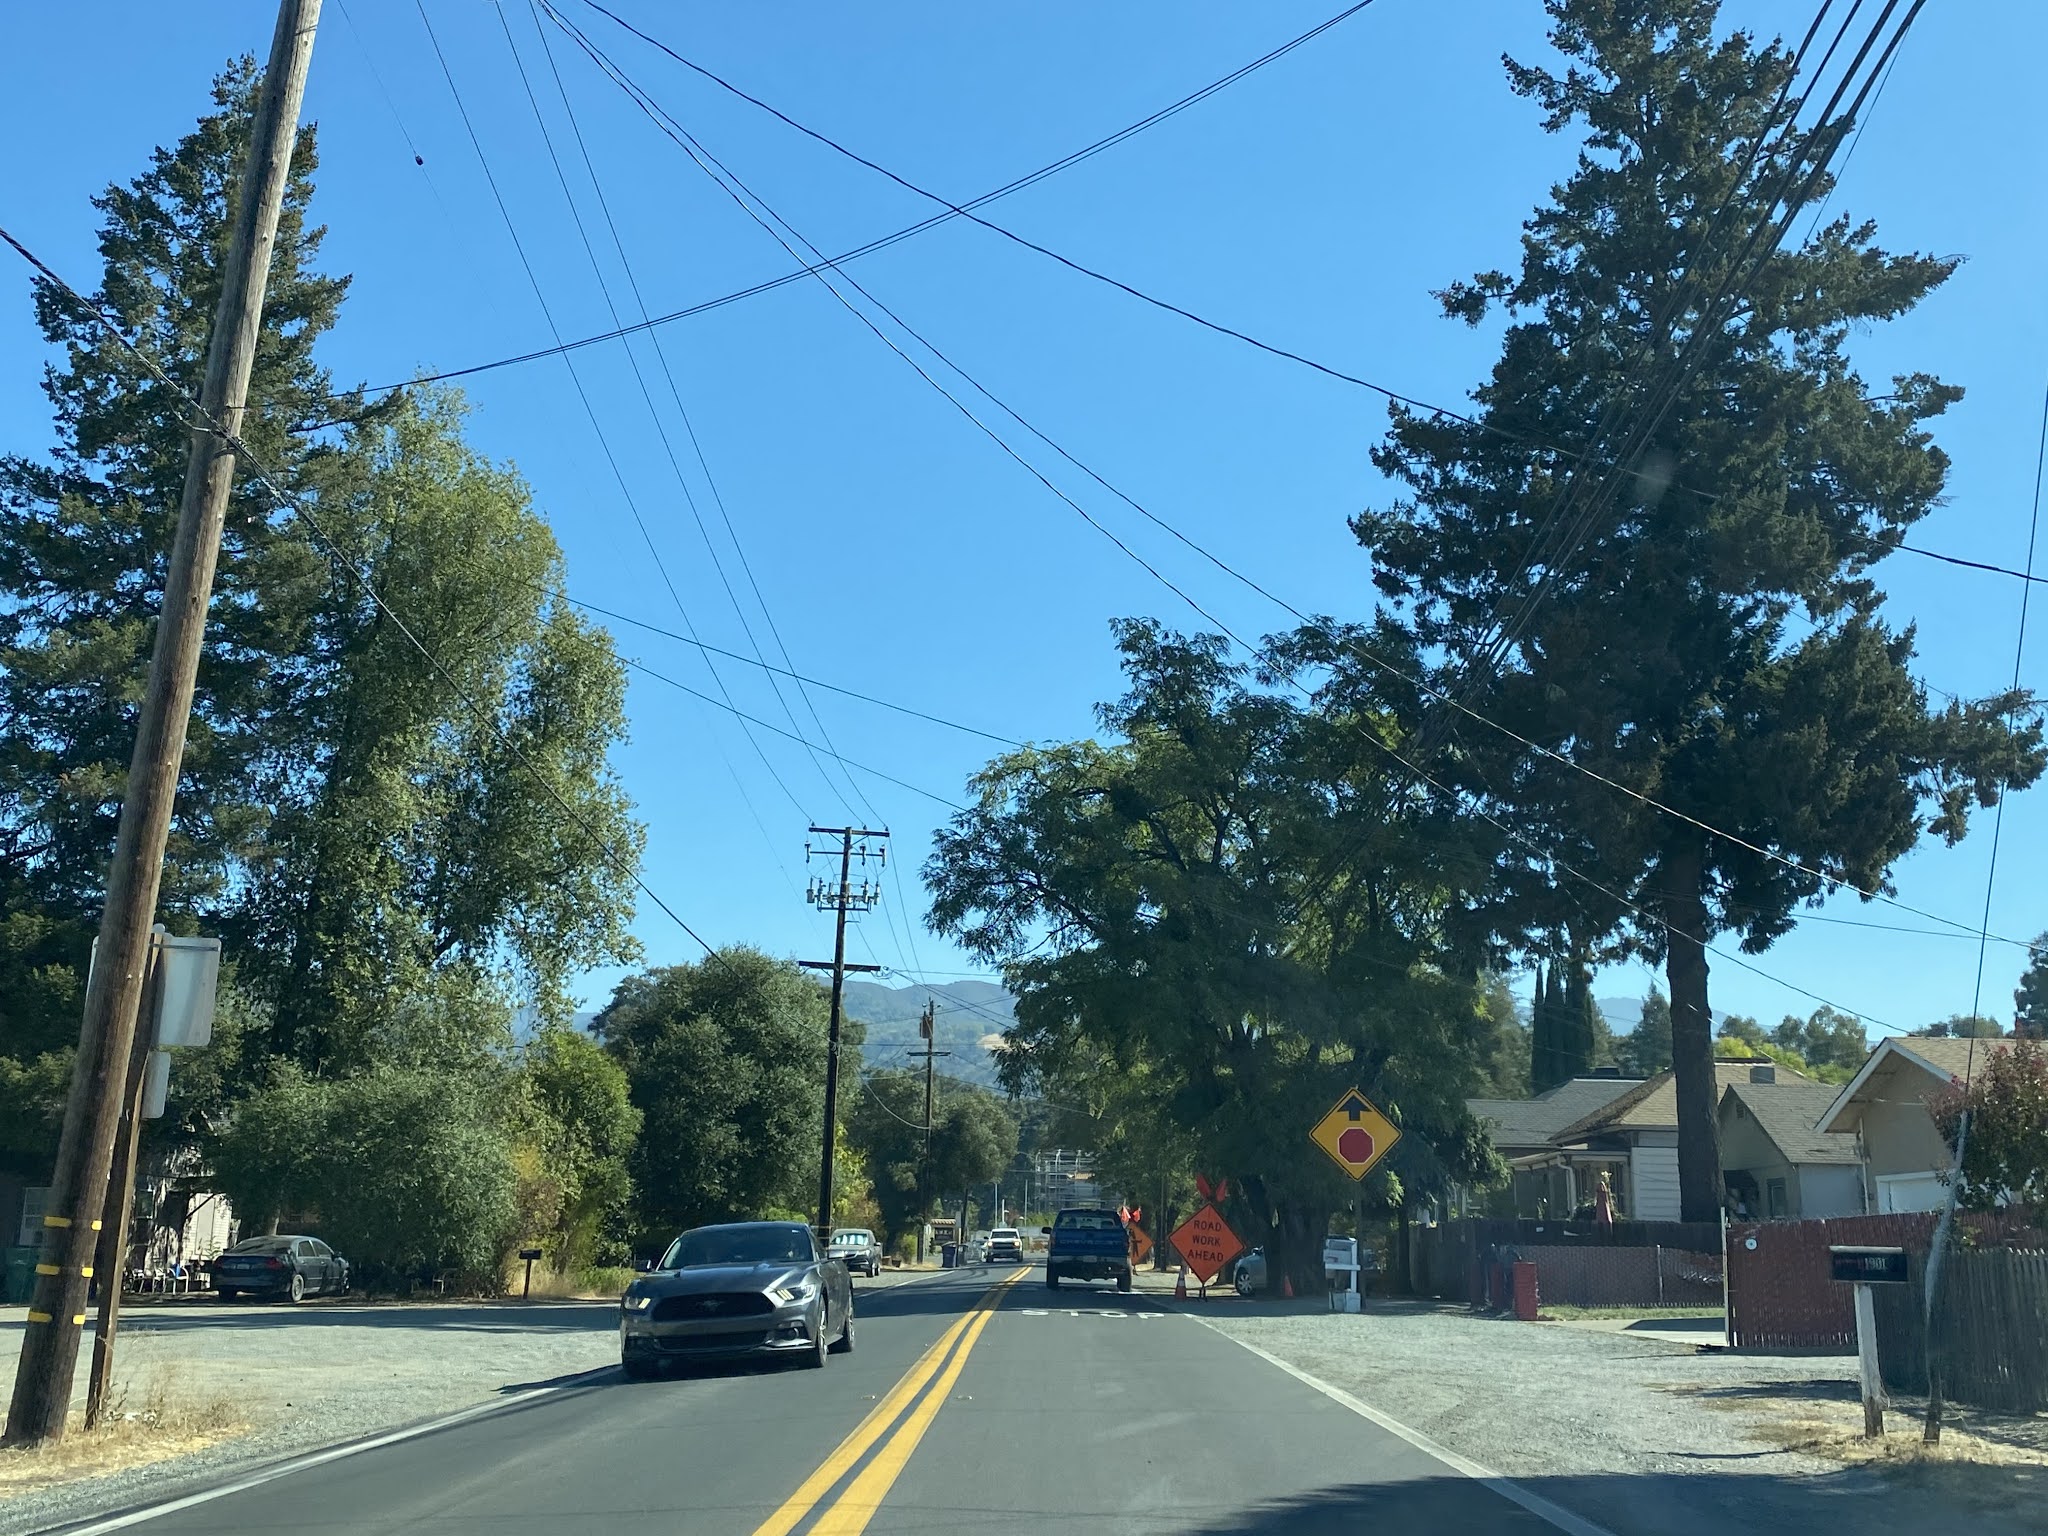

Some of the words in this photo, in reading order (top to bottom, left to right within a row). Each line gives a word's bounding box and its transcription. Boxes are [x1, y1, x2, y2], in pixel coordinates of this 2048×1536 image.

[1193, 1220, 1222, 1232] ROAD
[1192, 1235, 1221, 1247] WORK
[1187, 1249, 1224, 1263] AHEAD
[1021, 1308, 1165, 1319] STOP
